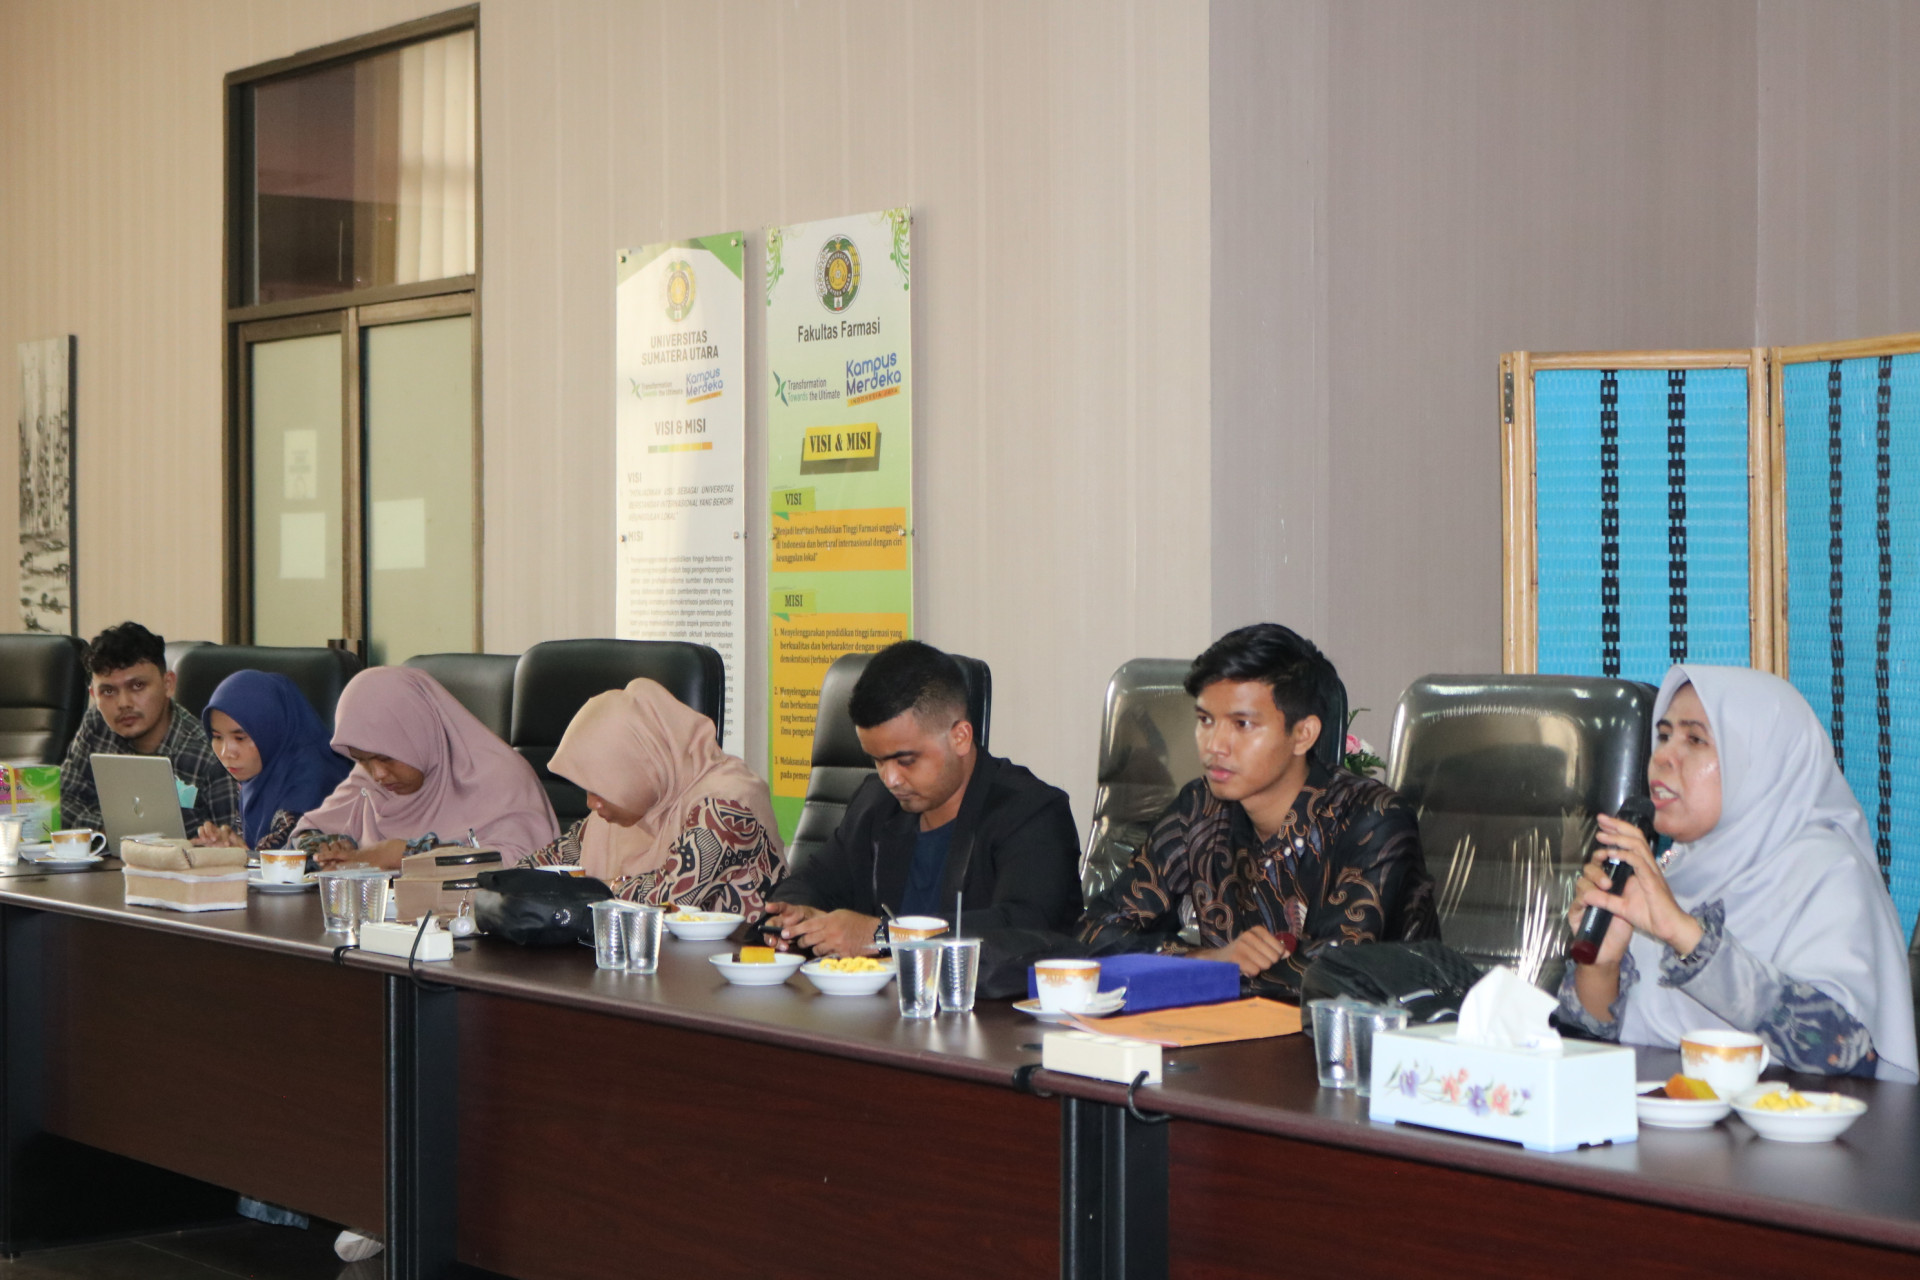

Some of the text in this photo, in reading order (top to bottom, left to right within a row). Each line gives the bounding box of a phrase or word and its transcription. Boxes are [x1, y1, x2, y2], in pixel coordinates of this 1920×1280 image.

[798, 316, 881, 343] Fakultas Farmasi
[650, 330, 708, 348] UNIVERSITAS
[641, 345, 719, 365] SUMATERA UTARA
[846, 352, 897, 378] Kampus
[686, 368, 720, 386] Kampus
[846, 369, 902, 397] Merdeka
[686, 380, 723, 398] Merdeka
[788, 378, 826, 391] Transformation
[788, 389, 840, 403] Towards the Ultimate
[654, 418, 706, 436] VISI & MISI
[810, 431, 872, 454] VISI & MISI
[628, 472, 642, 483] VISI
[701, 484, 734, 494] UNIVERSITAS
[785, 493, 802, 506] VISI
[815, 525, 842, 534] Pendidikan
[843, 525, 858, 535] Tinggi
[859, 524, 878, 533] Farmasi
[628, 531, 643, 542] MISI
[782, 540, 805, 548] Indonesia
[807, 540, 816, 548] dan
[838, 538, 872, 547] internasional
[873, 538, 892, 549] dengan
[784, 594, 804, 607] MISI
[825, 628, 854, 639] pendidikan
[855, 629, 869, 639] tinggi
[890, 630, 902, 640] yang
[780, 641, 810, 650] berkualitas
[811, 641, 821, 650] dan
[821, 641, 854, 650] berkarakter
[855, 641, 874, 653] dengan
[780, 700, 789, 708] dan
[780, 715, 791, 724] yang
[780, 770, 792, 781] pada
